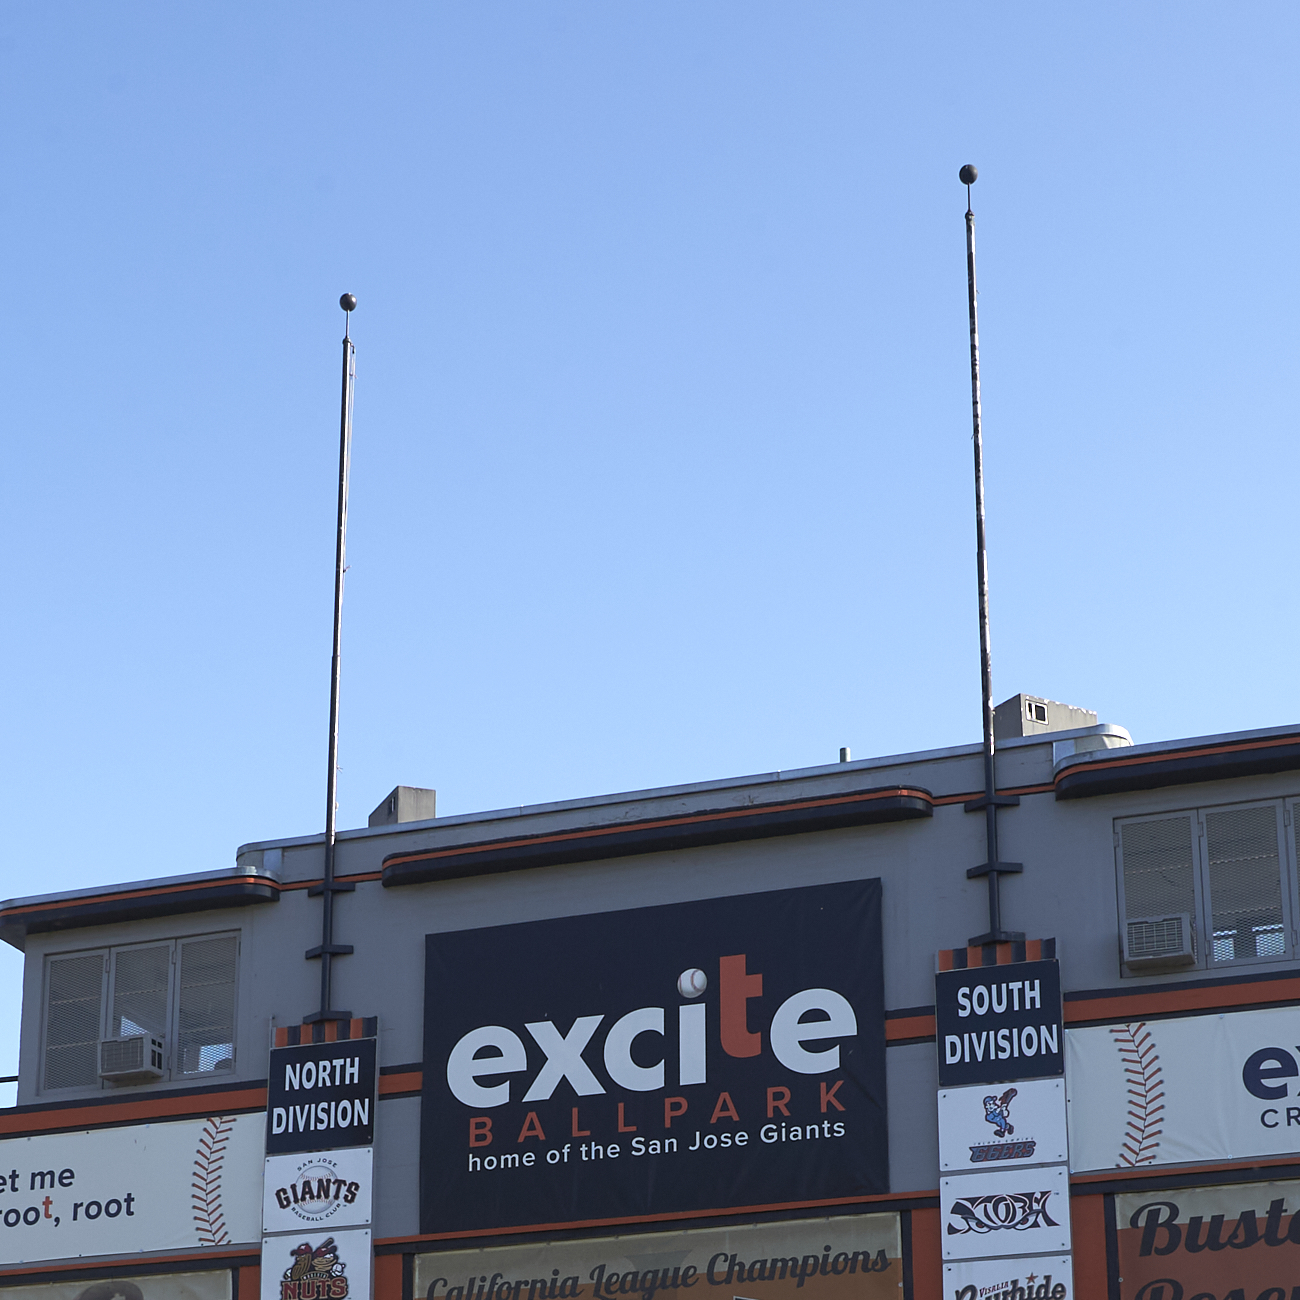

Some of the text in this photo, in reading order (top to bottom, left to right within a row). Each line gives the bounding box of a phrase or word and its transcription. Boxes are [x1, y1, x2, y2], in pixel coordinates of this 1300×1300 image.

[957, 979, 1041, 1017] SOUTH
[447, 954, 858, 1109] excite
[945, 1023, 1059, 1066] DIVISION
[285, 1056, 360, 1092] NORTH
[272, 1098, 370, 1135] DIVISION
[469, 1080, 847, 1148] BALLPARK
[468, 1119, 847, 1172] home of the San Jose Giants
[30, 1170, 75, 1192] me
[275, 1178, 360, 1209] GIANTS
[72, 1192, 136, 1222] root
[706, 1245, 892, 1288] Champions
